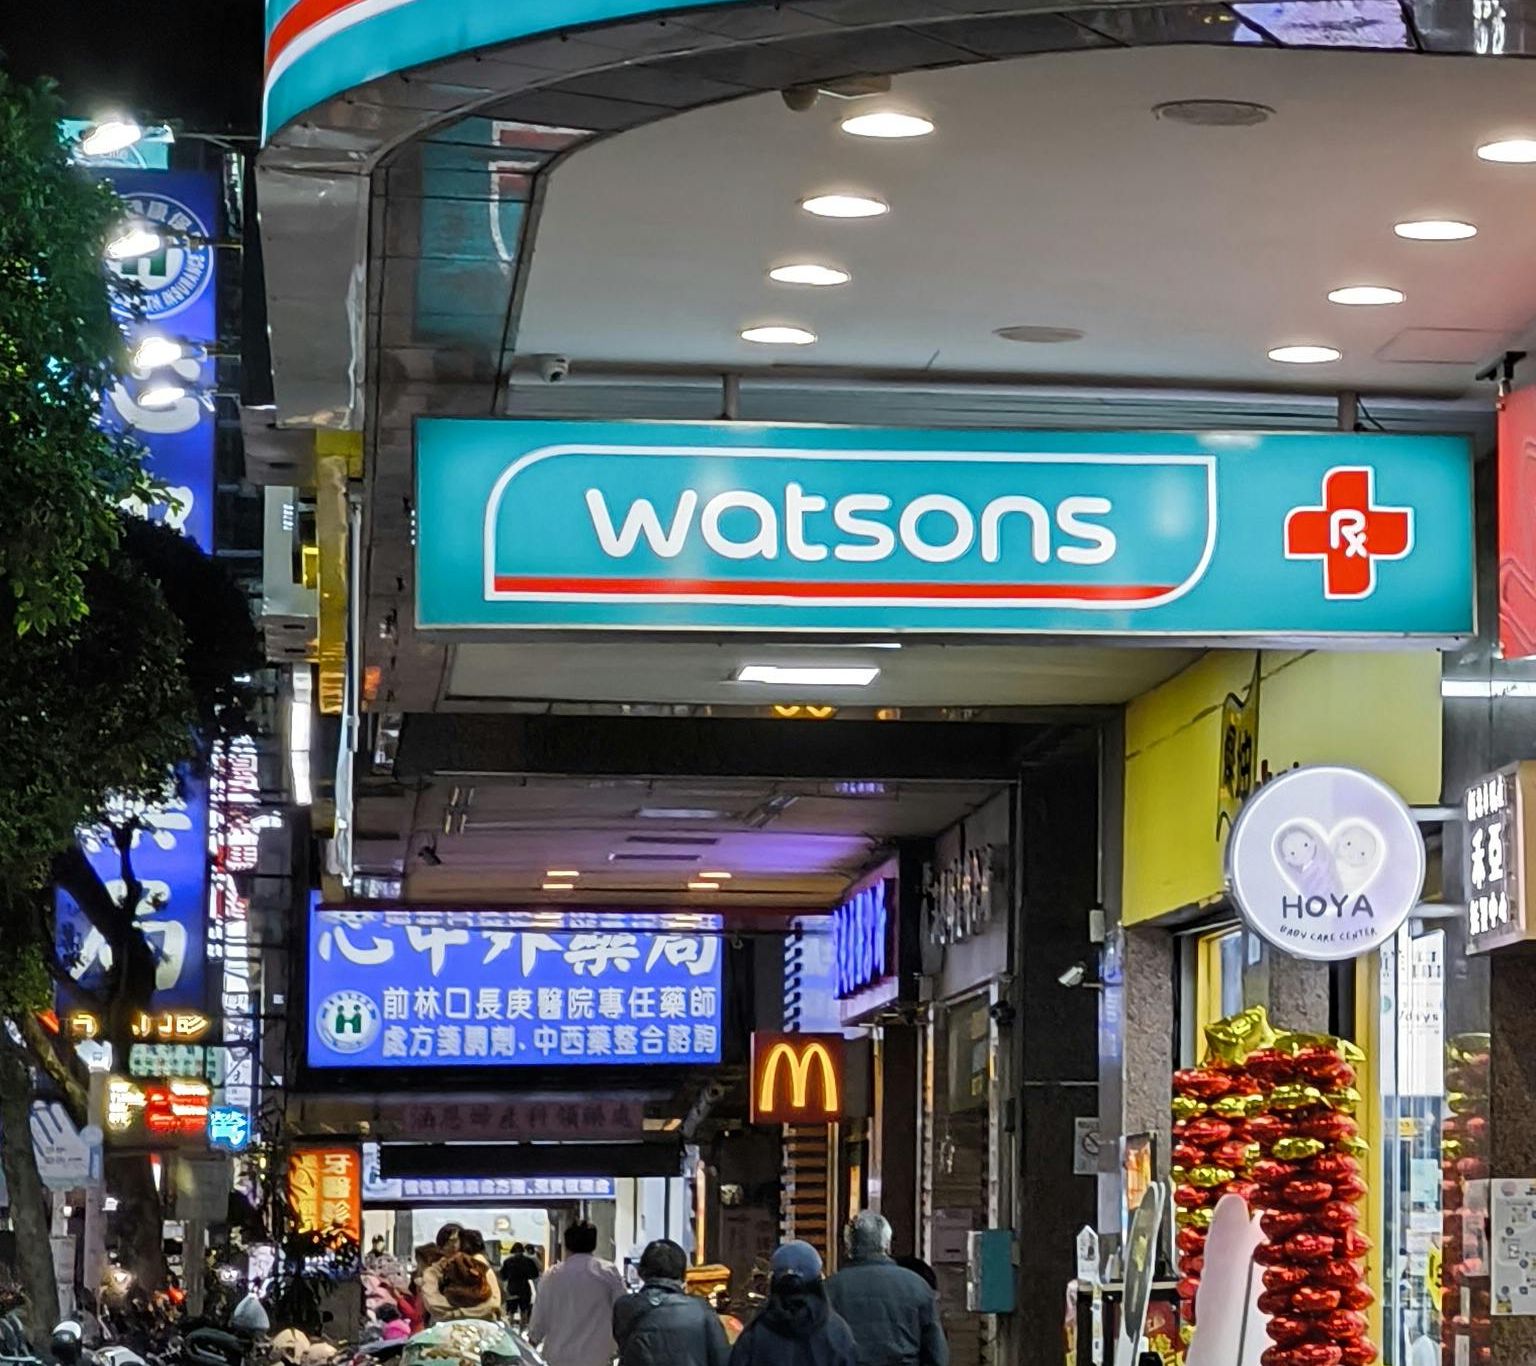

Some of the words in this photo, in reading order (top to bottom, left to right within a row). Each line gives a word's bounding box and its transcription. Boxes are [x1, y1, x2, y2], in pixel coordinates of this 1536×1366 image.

[586, 481, 1116, 565] watsons
[1282, 893, 1374, 919] HOYA
[383, 986, 717, 1021] 前林口長庚醫院專任藥師
